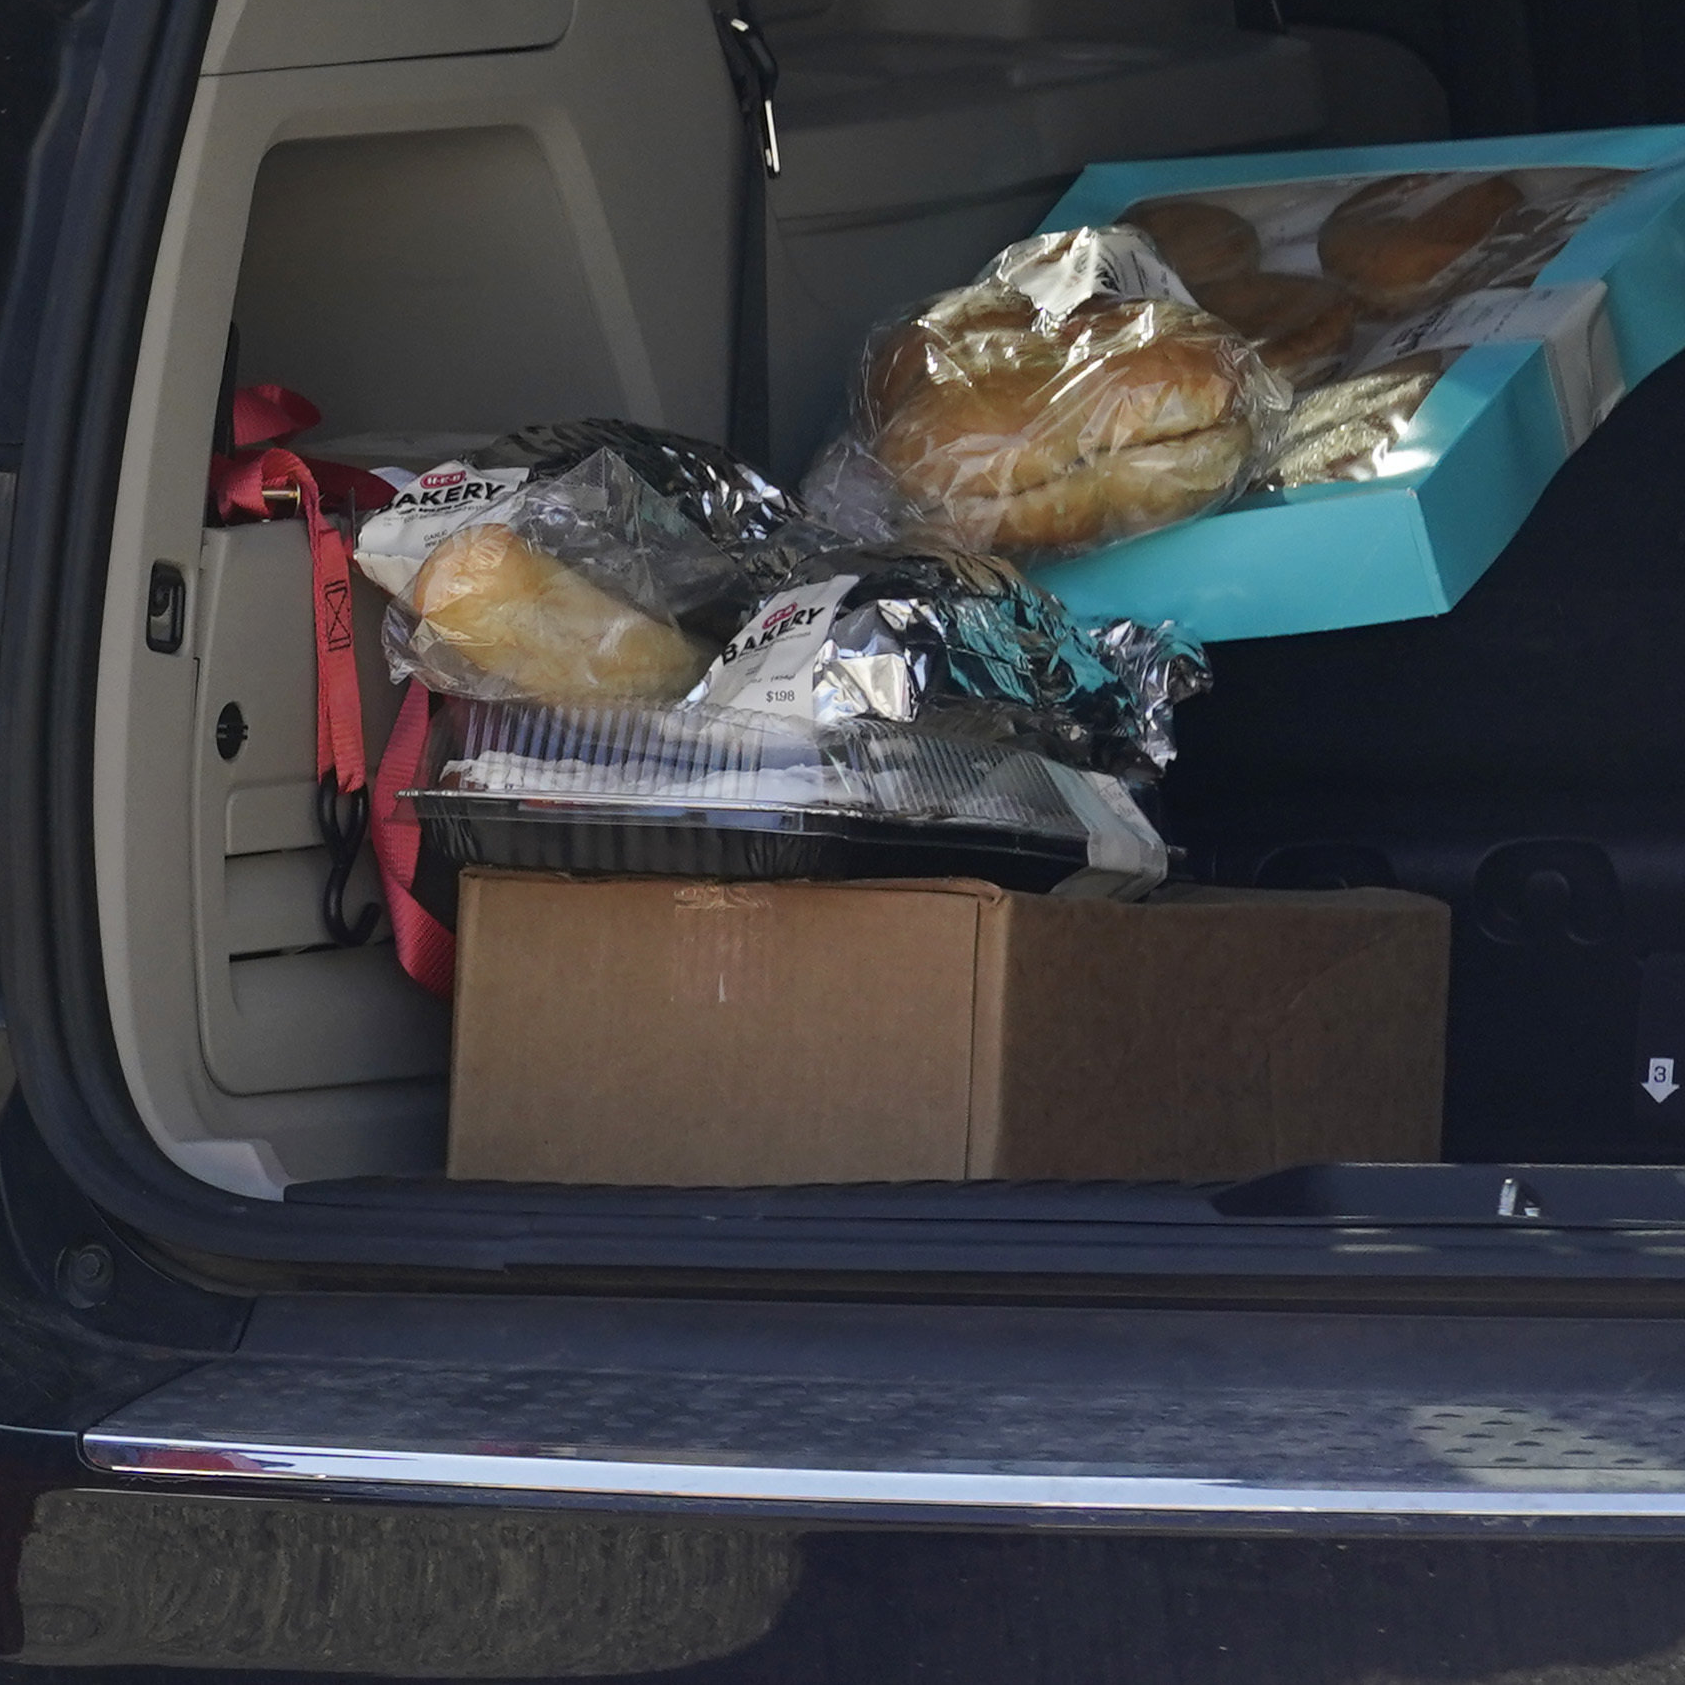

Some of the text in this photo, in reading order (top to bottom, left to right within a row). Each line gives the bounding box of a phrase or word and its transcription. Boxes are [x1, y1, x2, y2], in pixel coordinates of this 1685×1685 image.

[721, 607, 825, 666] BAKERY
[766, 689, 795, 703] $1.98
[1654, 1065, 1666, 1083] 3
